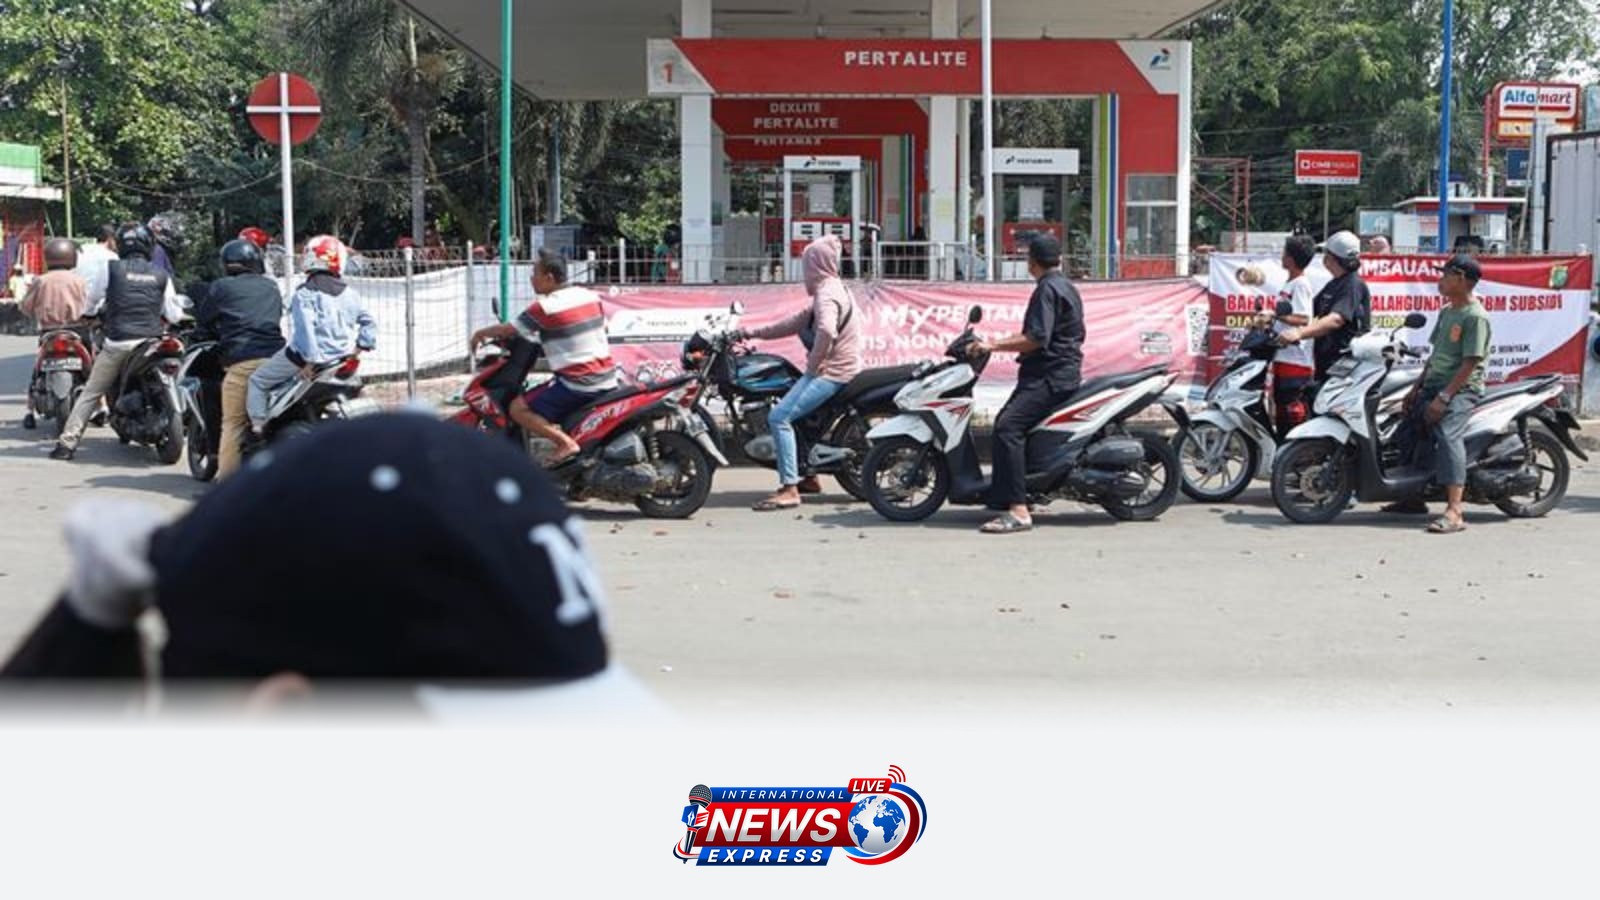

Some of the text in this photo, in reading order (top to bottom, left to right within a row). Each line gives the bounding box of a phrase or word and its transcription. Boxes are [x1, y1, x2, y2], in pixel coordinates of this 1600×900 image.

[844, 51, 968, 67] PERTALITE
[662, 62, 673, 84] 1
[1503, 89, 1572, 105] Alfamart
[769, 102, 821, 113] DEXLITE
[753, 117, 840, 129] PERTALITE
[1509, 293, 1563, 311] SUBSIDI
